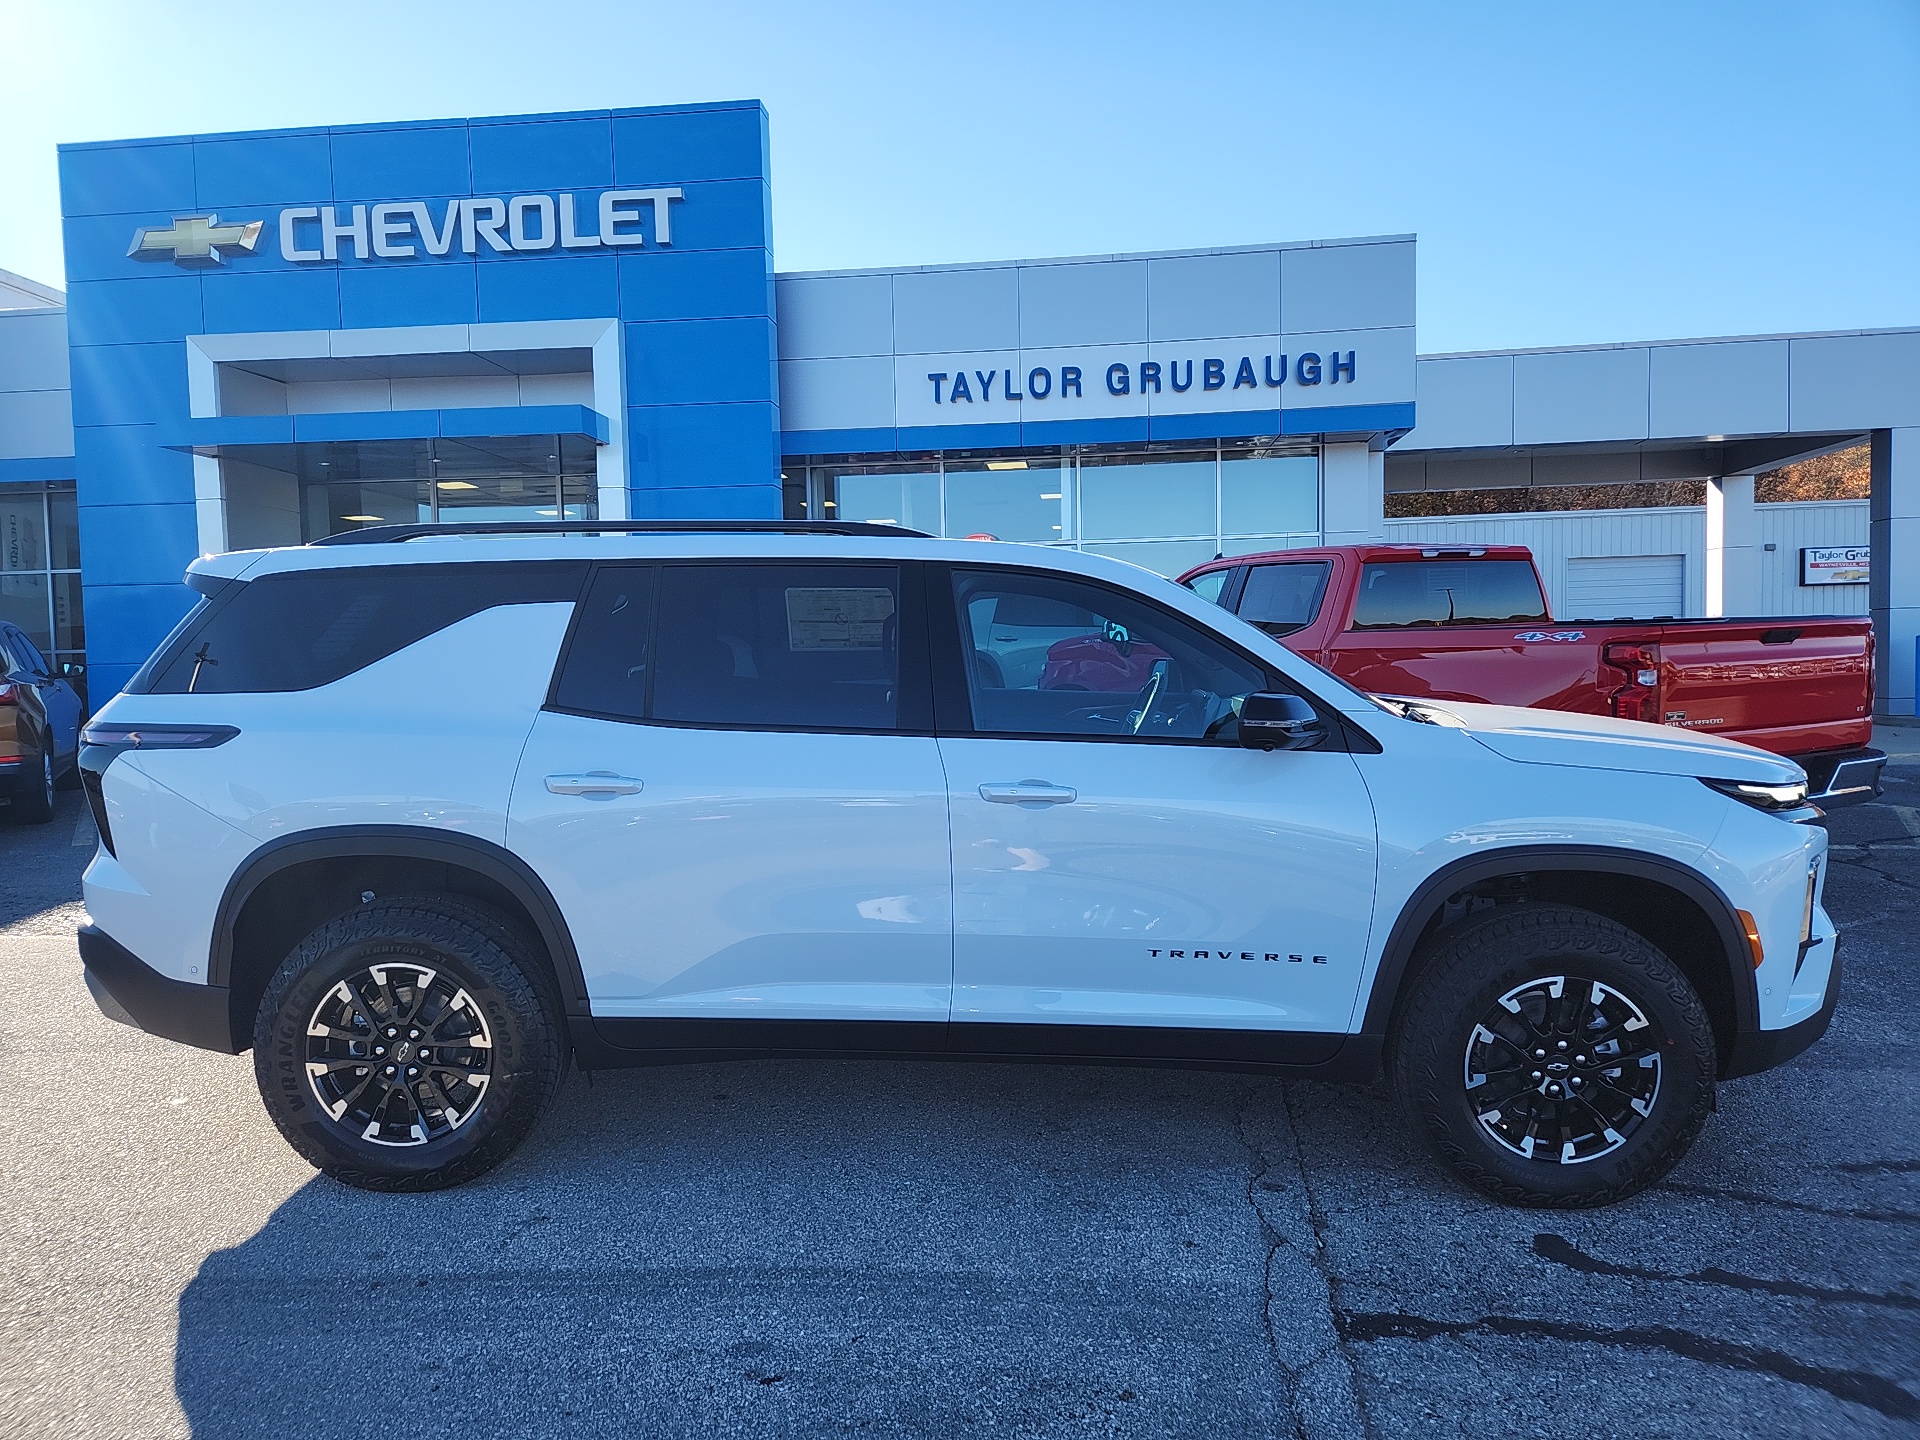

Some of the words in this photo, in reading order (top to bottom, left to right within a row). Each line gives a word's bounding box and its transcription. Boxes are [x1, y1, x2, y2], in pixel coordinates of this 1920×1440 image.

[279, 187, 684, 263] CHEVROLET
[927, 366, 1083, 404] TAYLOR
[1105, 350, 1357, 396] GRUBAUGH
[1810, 551, 1843, 562] Taylor
[1665, 718, 1724, 727] SILVERADO
[358, 943, 427, 958] TERRITORY
[1147, 949, 1328, 965] TRAVERSE
[277, 981, 314, 1113] WRANGLER
